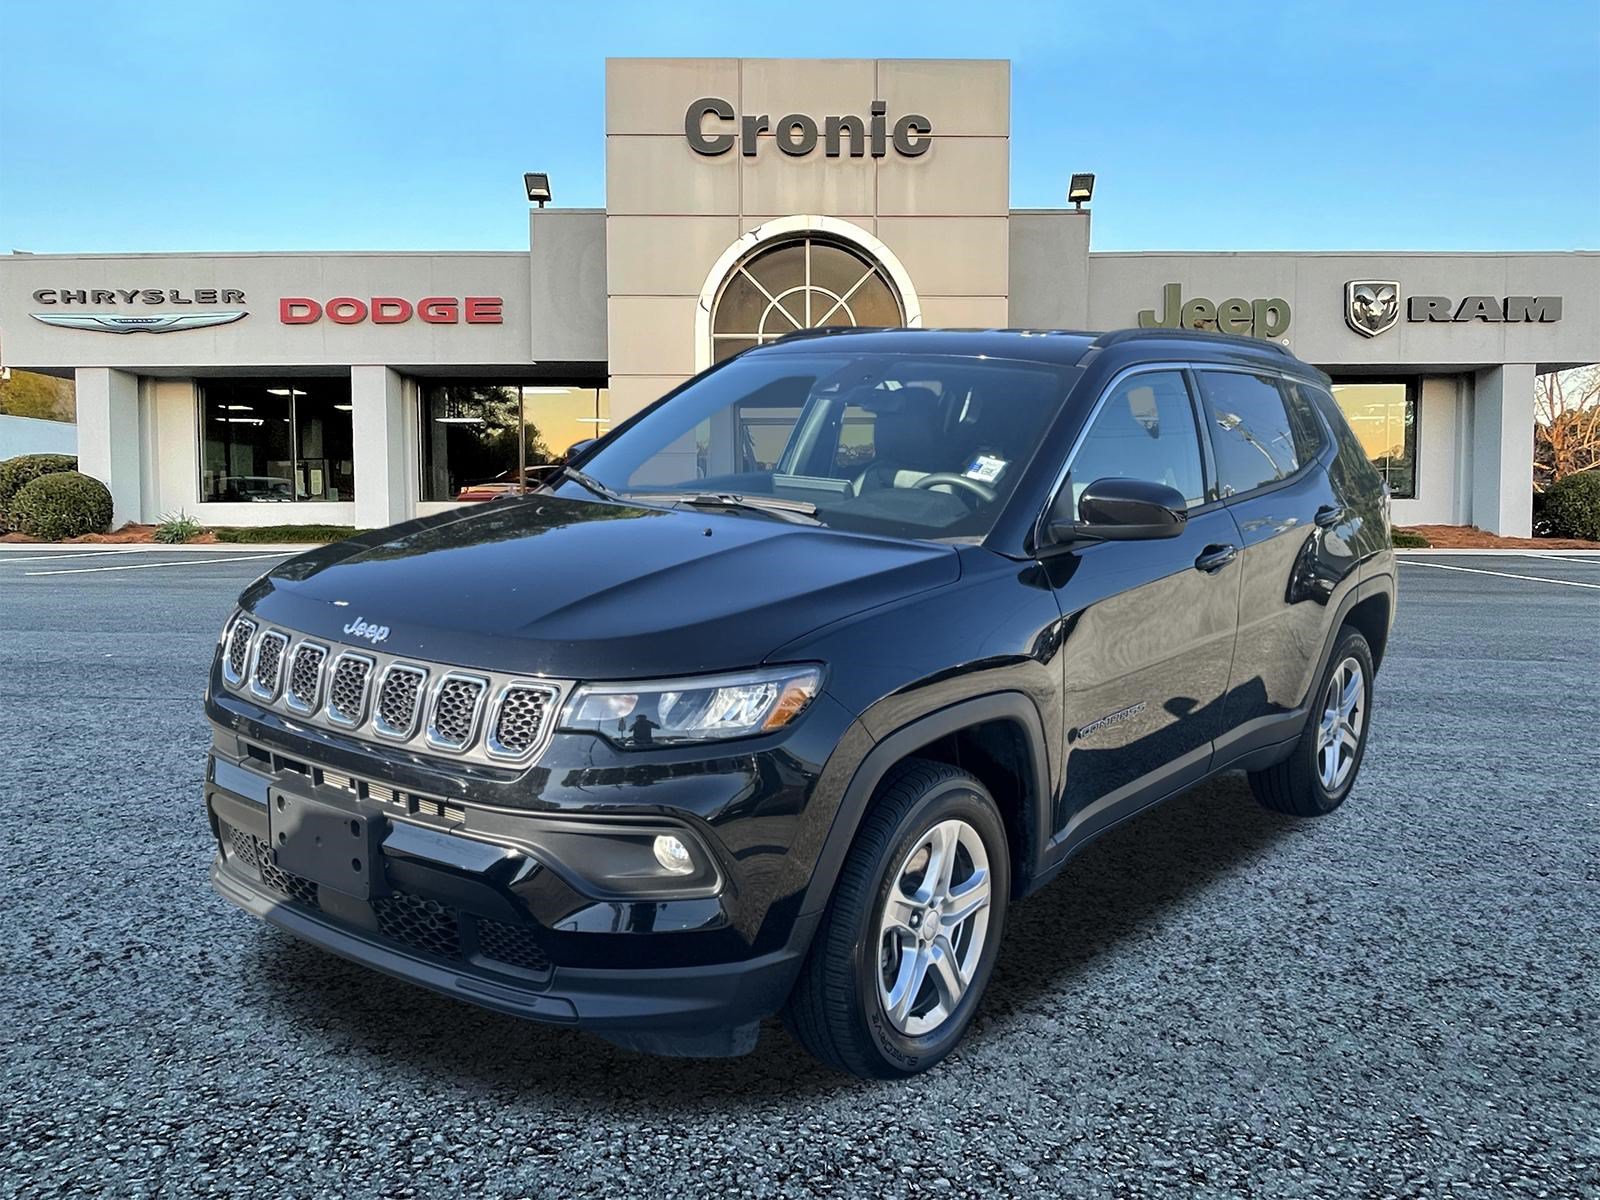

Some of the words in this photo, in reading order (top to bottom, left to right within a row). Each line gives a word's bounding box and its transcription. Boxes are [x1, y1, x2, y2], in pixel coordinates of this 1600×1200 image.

[685, 97, 933, 157] Cronic
[32, 289, 246, 305] CHRYSLER
[279, 297, 504, 325] DODGE
[1407, 296, 1563, 323] RAM
[1138, 283, 1291, 341] Jeep
[343, 616, 391, 644] Jeep
